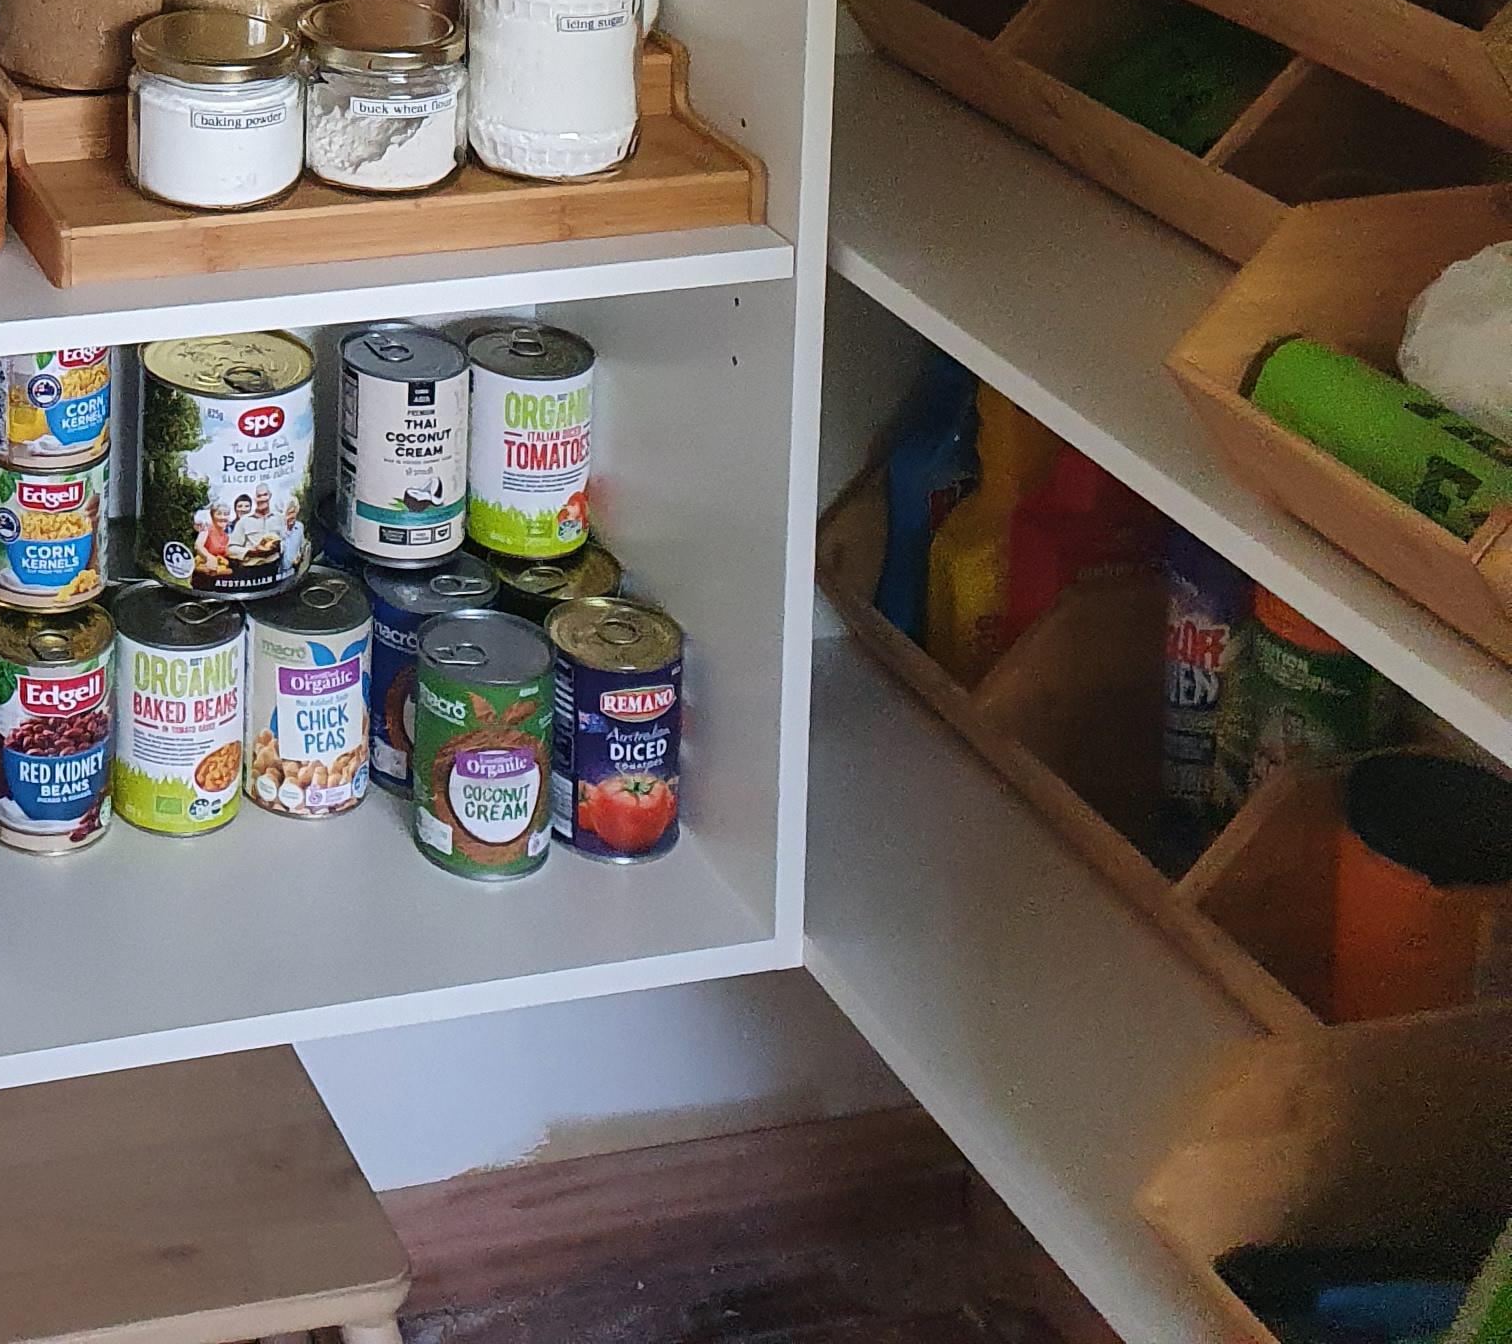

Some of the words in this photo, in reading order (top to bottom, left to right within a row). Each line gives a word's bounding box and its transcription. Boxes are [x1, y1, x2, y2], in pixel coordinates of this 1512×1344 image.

[566, 15, 594, 32] icing
[597, 14, 625, 30] sugar
[359, 99, 389, 115] buck
[393, 97, 428, 114] wheat
[432, 96, 453, 112] flour
[200, 112, 241, 130] baking
[245, 110, 282, 129] powder
[65, 394, 105, 419] CORN
[243, 413, 280, 436] spc
[404, 418, 438, 431] THAI
[385, 428, 453, 444] COCONUT
[222, 450, 296, 473] Peaches
[395, 445, 443, 459] CREAM
[22, 485, 80, 510] Edgell
[21, 555, 81, 571] KERNELS
[24, 544, 76, 561] CORN
[134, 646, 239, 699] ORGANIC
[290, 671, 354, 695] Organic
[26, 675, 101, 711] Edgell
[603, 688, 676, 714] REMANO
[133, 691, 187, 724] BAKED
[193, 687, 239, 724] BEANS
[304, 727, 346, 755] PEAS
[609, 739, 668, 762] DICED
[19, 760, 52, 786] RED
[54, 752, 105, 784] KIDNEY
[466, 756, 528, 778] Organic
[40, 781, 91, 798] BEANS
[463, 784, 531, 802] COCONUT
[464, 802, 529, 822] CREAM
